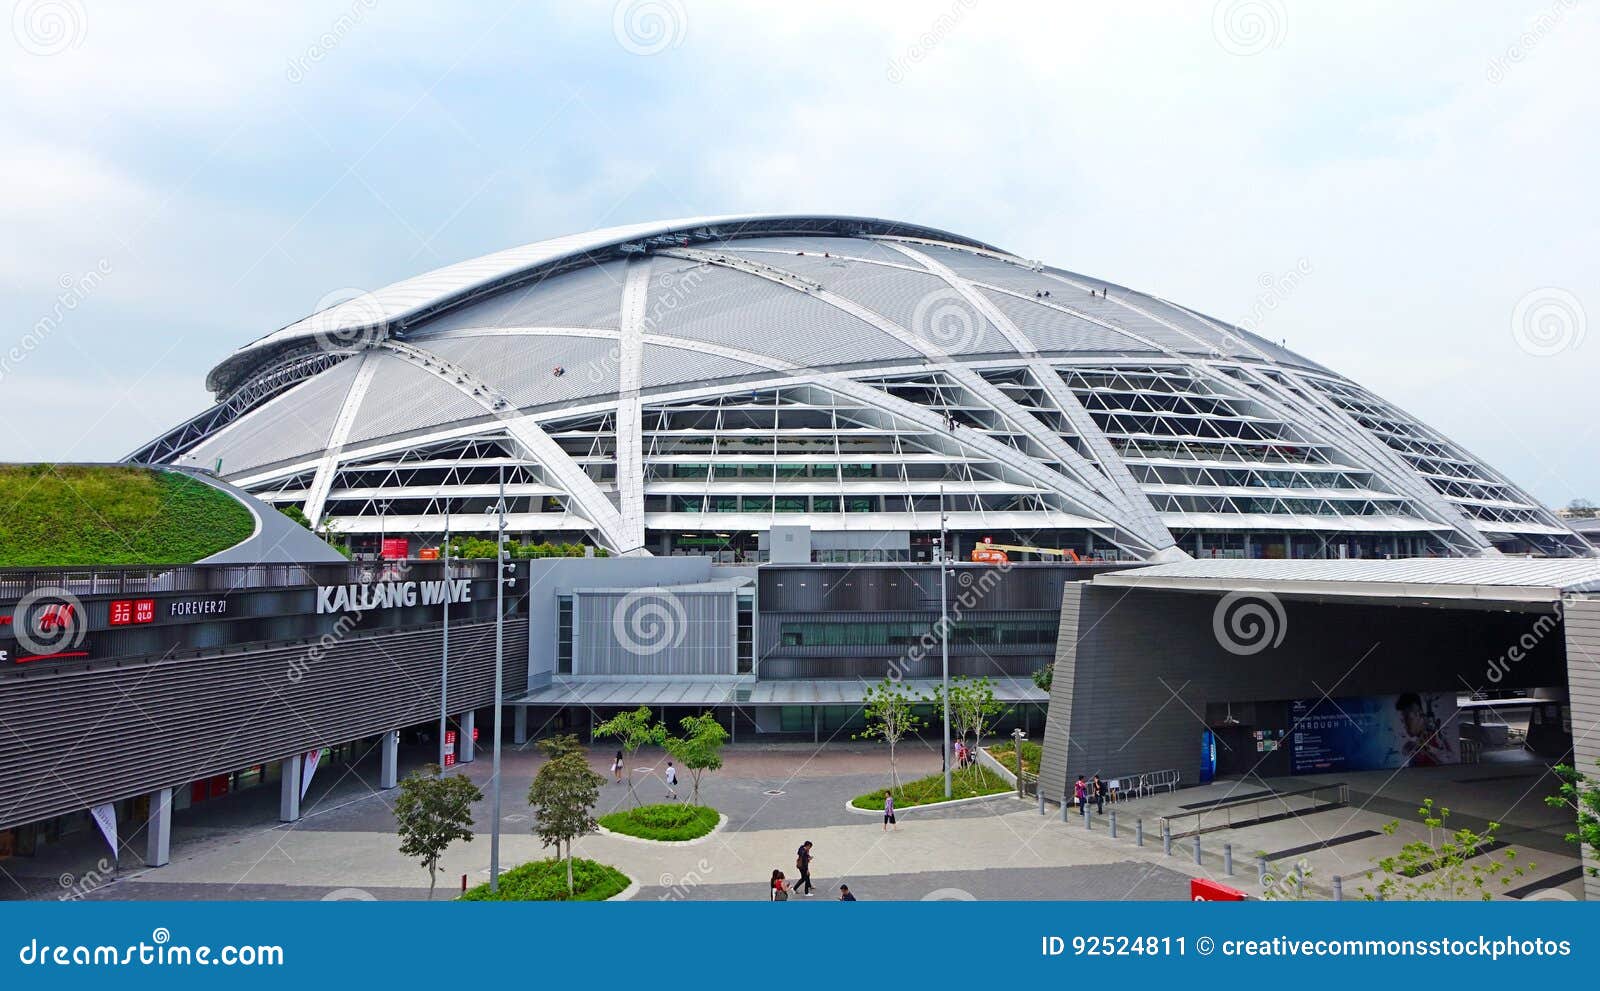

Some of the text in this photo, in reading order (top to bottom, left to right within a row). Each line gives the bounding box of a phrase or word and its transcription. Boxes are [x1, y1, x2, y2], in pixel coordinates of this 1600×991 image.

[171, 600, 226, 616] FOREVER 21
[316, 579, 472, 614] KALLANG WAVE
